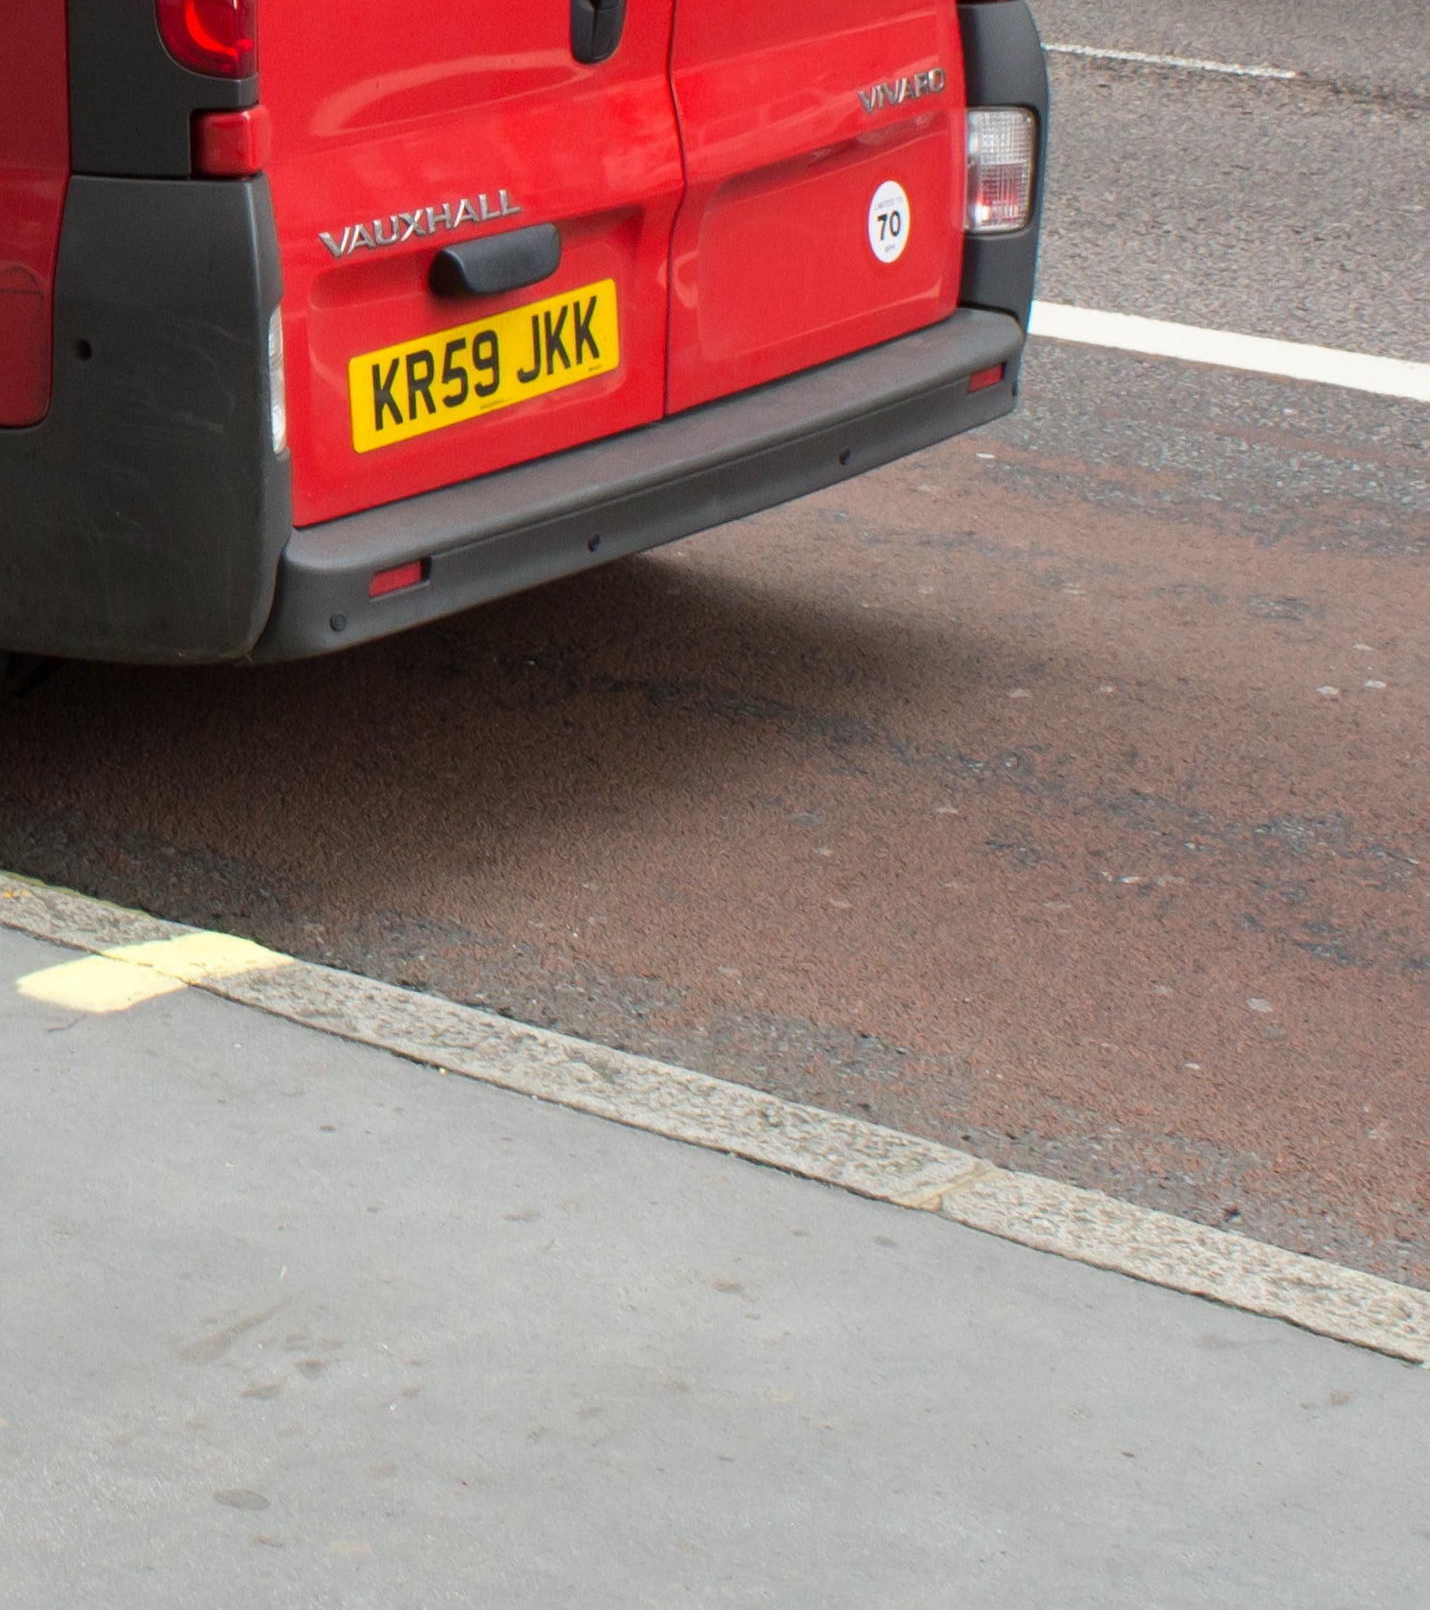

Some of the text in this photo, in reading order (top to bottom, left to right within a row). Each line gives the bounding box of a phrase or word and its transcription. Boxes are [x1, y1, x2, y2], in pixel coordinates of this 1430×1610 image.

[857, 67, 947, 115] VIVARO
[318, 189, 522, 259] VAUXHALL
[877, 210, 901, 241] 70
[371, 294, 601, 431] KR59 JKK
